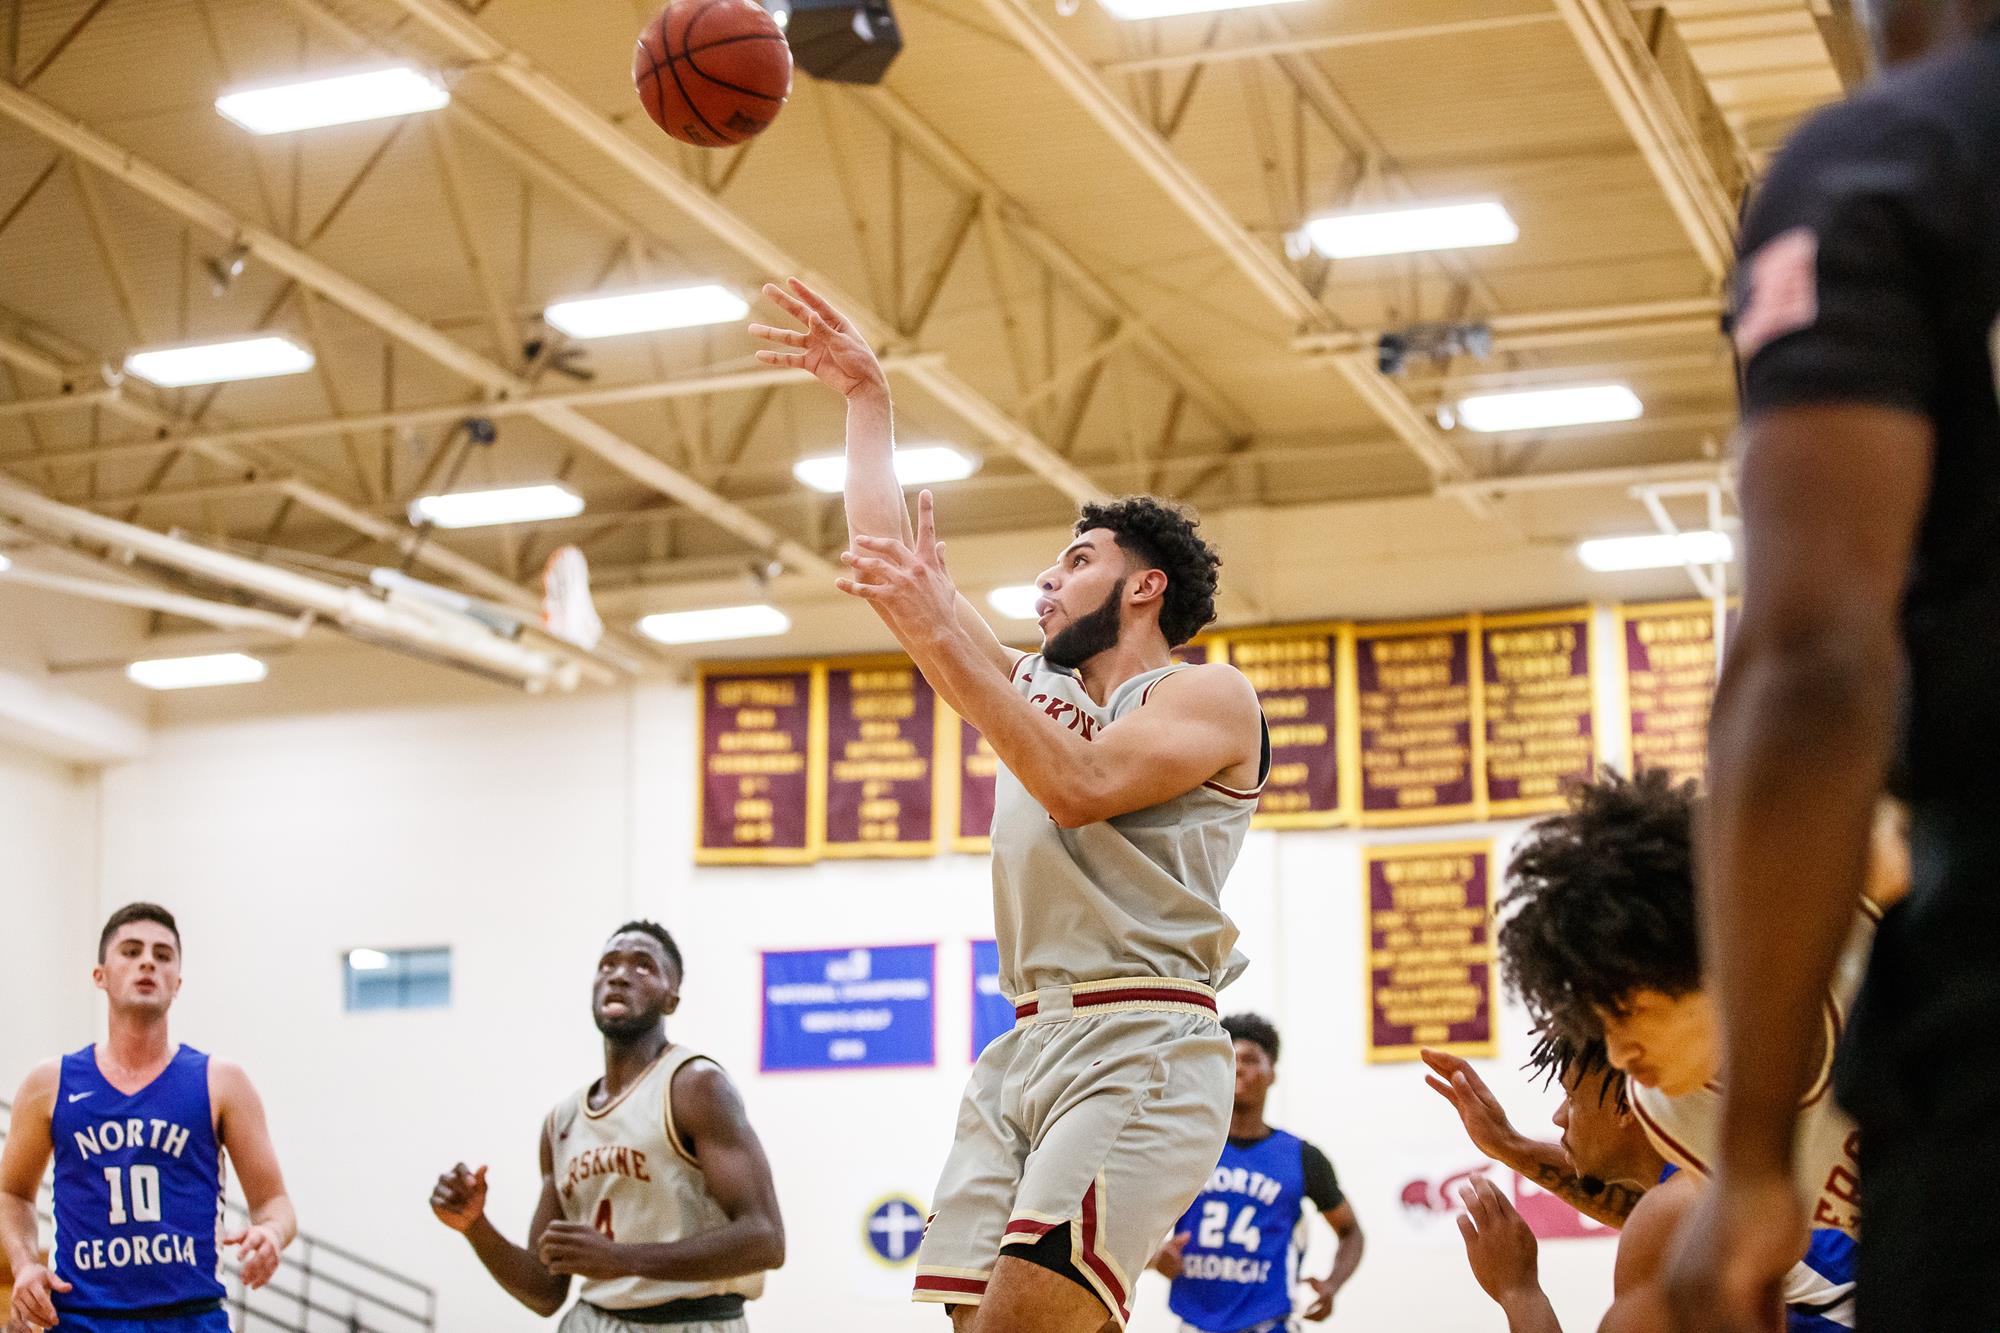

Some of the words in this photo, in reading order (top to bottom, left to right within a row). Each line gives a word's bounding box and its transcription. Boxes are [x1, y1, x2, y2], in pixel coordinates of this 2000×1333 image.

[74, 1118, 190, 1160] NORTH
[103, 1164, 162, 1225] 10
[1198, 1200, 1261, 1254] 24
[74, 1233, 197, 1271] GEORGIA
